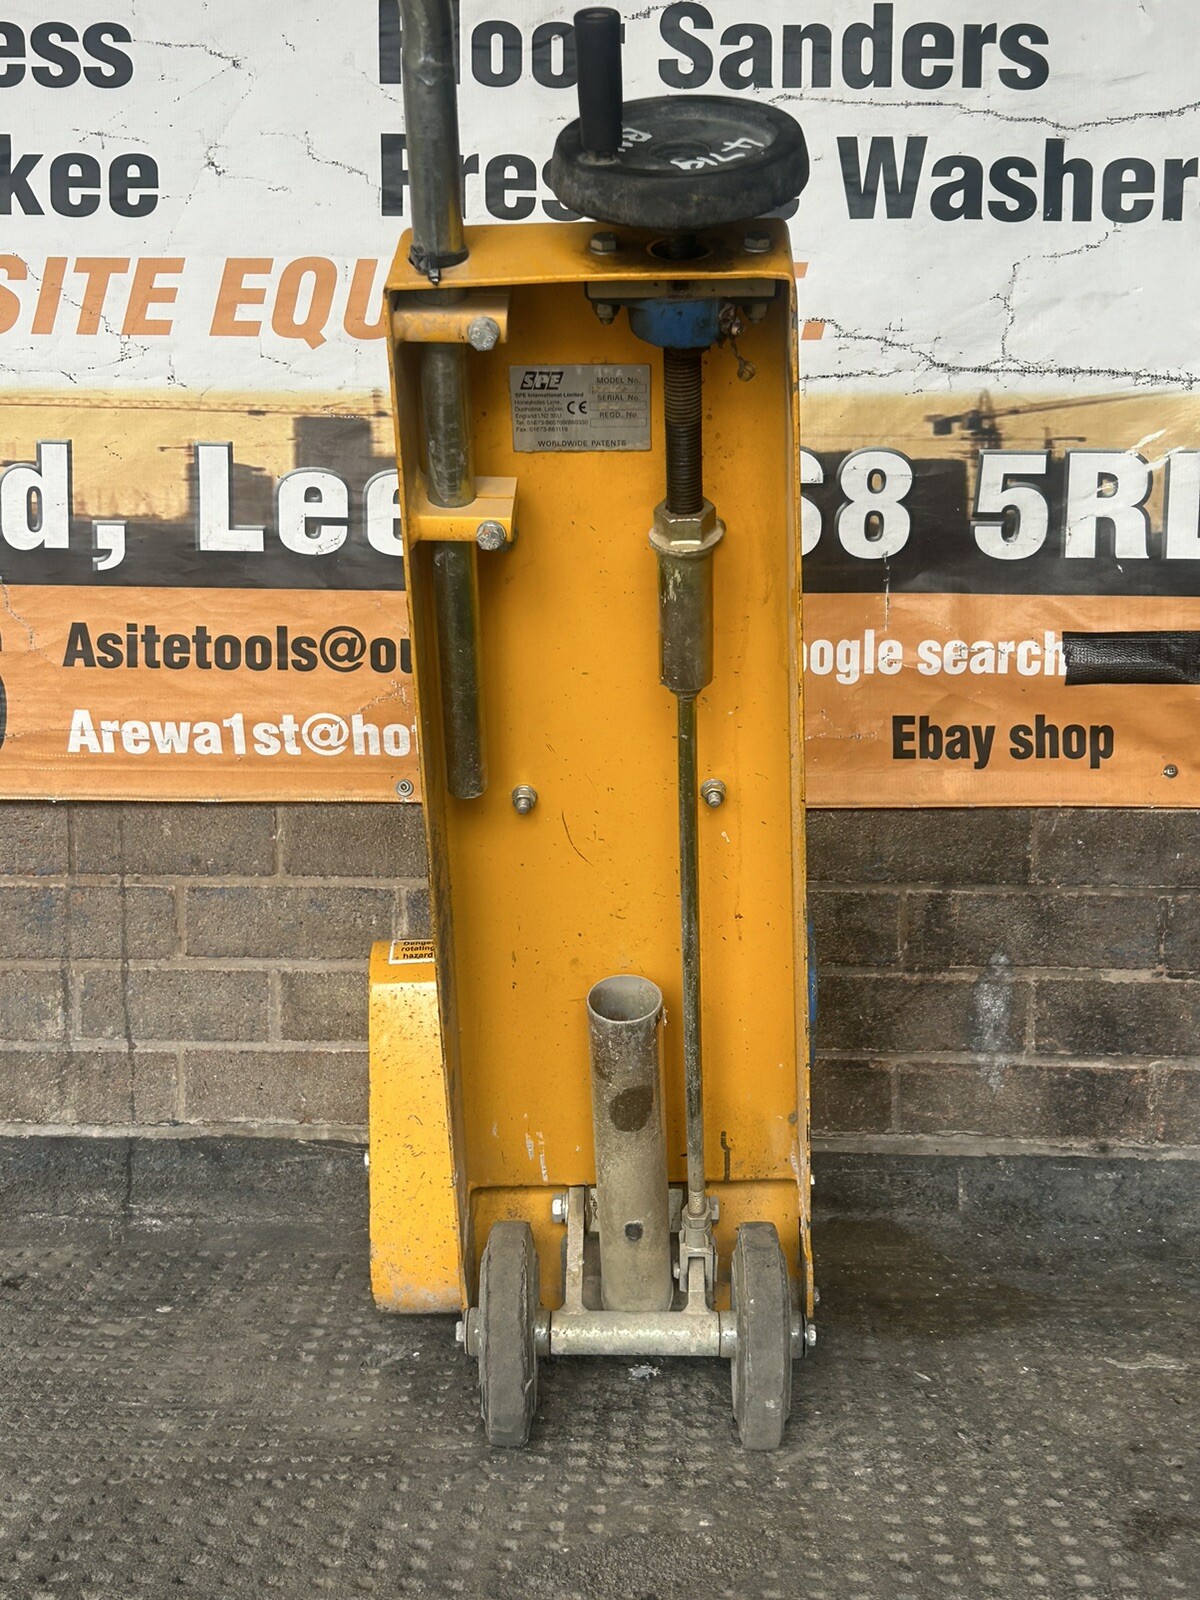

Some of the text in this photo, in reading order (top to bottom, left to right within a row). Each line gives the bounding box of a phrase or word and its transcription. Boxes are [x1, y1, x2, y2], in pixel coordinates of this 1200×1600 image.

[658, 2, 1049, 90] Sanders
[0, 134, 160, 218] kee
[836, 135, 1199, 222] Washer
[520, 371, 564, 390] SPE
[802, 630, 903, 685] ogle
[917, 631, 1066, 677] search
[68, 709, 1115, 770] Arewa1st@ho Ebay shop
